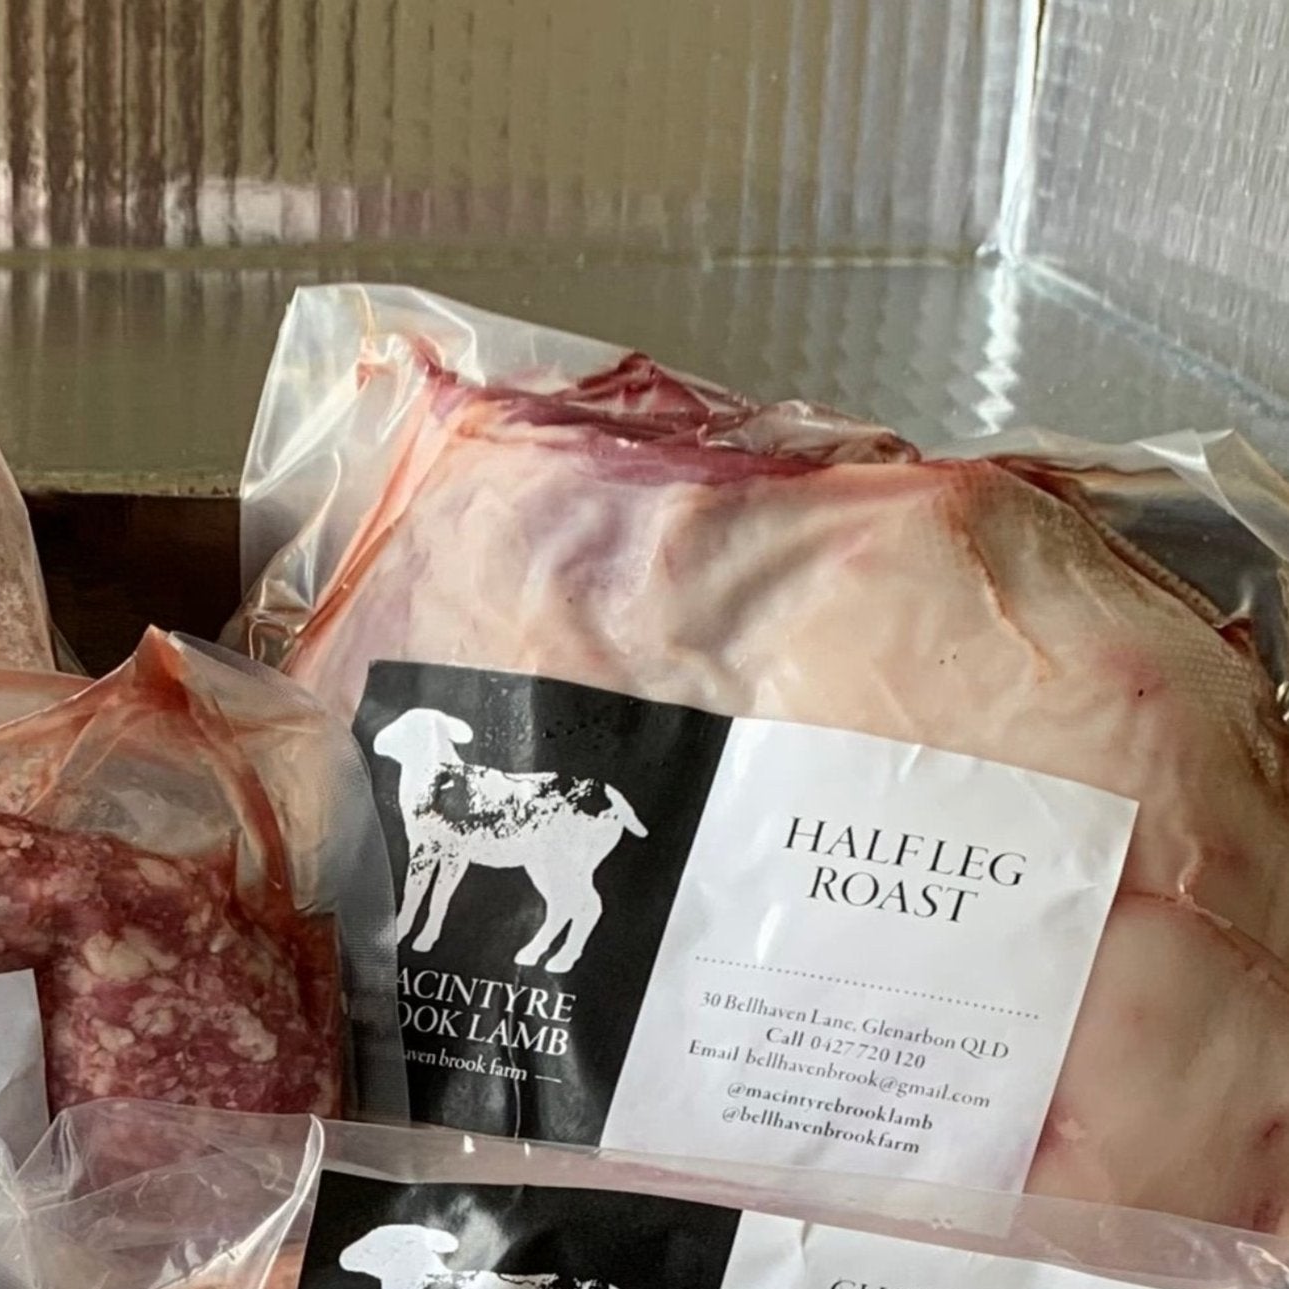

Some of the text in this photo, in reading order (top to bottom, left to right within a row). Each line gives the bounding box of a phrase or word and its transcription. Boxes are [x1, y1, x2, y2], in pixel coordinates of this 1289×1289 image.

[783, 817, 1027, 887] HALF LEG
[806, 866, 979, 923] ROAST
[397, 967, 577, 1023] ACINTYRE
[466, 1014, 569, 1056] LAMB
[700, 991, 1010, 1059] 30 Bellhaven Lane, Glenarbon QLD
[766, 1027, 805, 1047] Call
[439, 1048, 487, 1074] brook
[489, 1055, 527, 1081] farm
[688, 1039, 991, 1109] Email bellhavenbrook@gmail.com
[722, 1106, 920, 1154] @bellhavenbrookfarm
[727, 1082, 933, 1131] @macintyrebrooklamb
